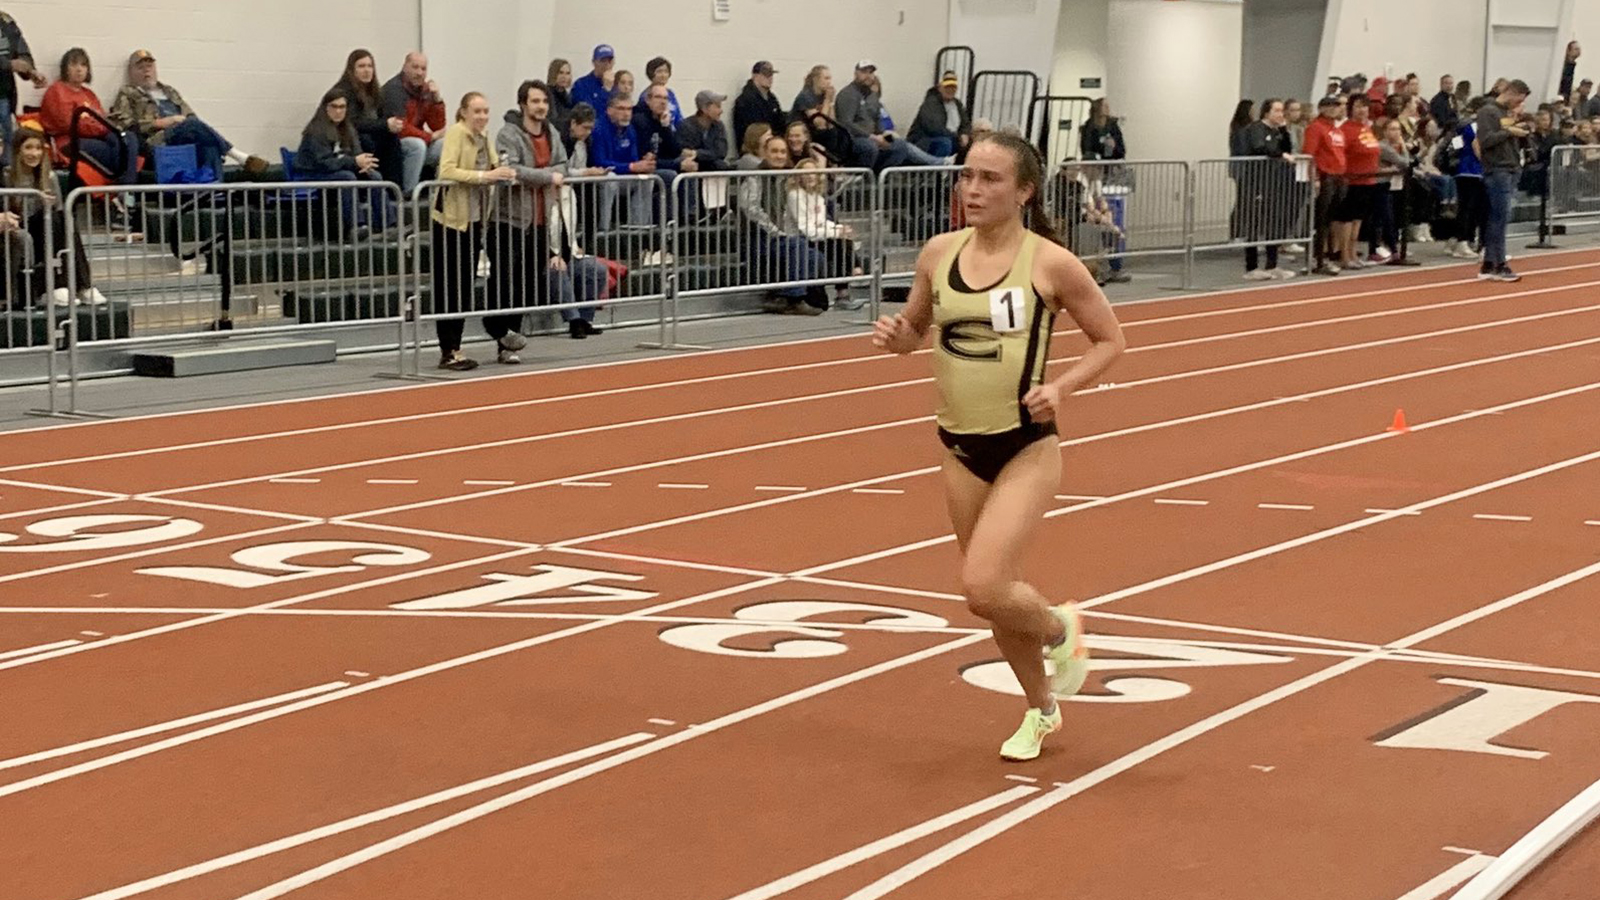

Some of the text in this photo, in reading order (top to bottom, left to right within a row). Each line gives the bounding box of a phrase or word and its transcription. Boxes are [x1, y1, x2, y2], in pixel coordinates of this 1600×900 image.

[1000, 291, 1015, 329] 1
[132, 540, 432, 588] 5
[388, 563, 660, 610] 4
[658, 600, 949, 658] 3
[960, 632, 1296, 703] 2
[1370, 676, 1600, 760] 1
